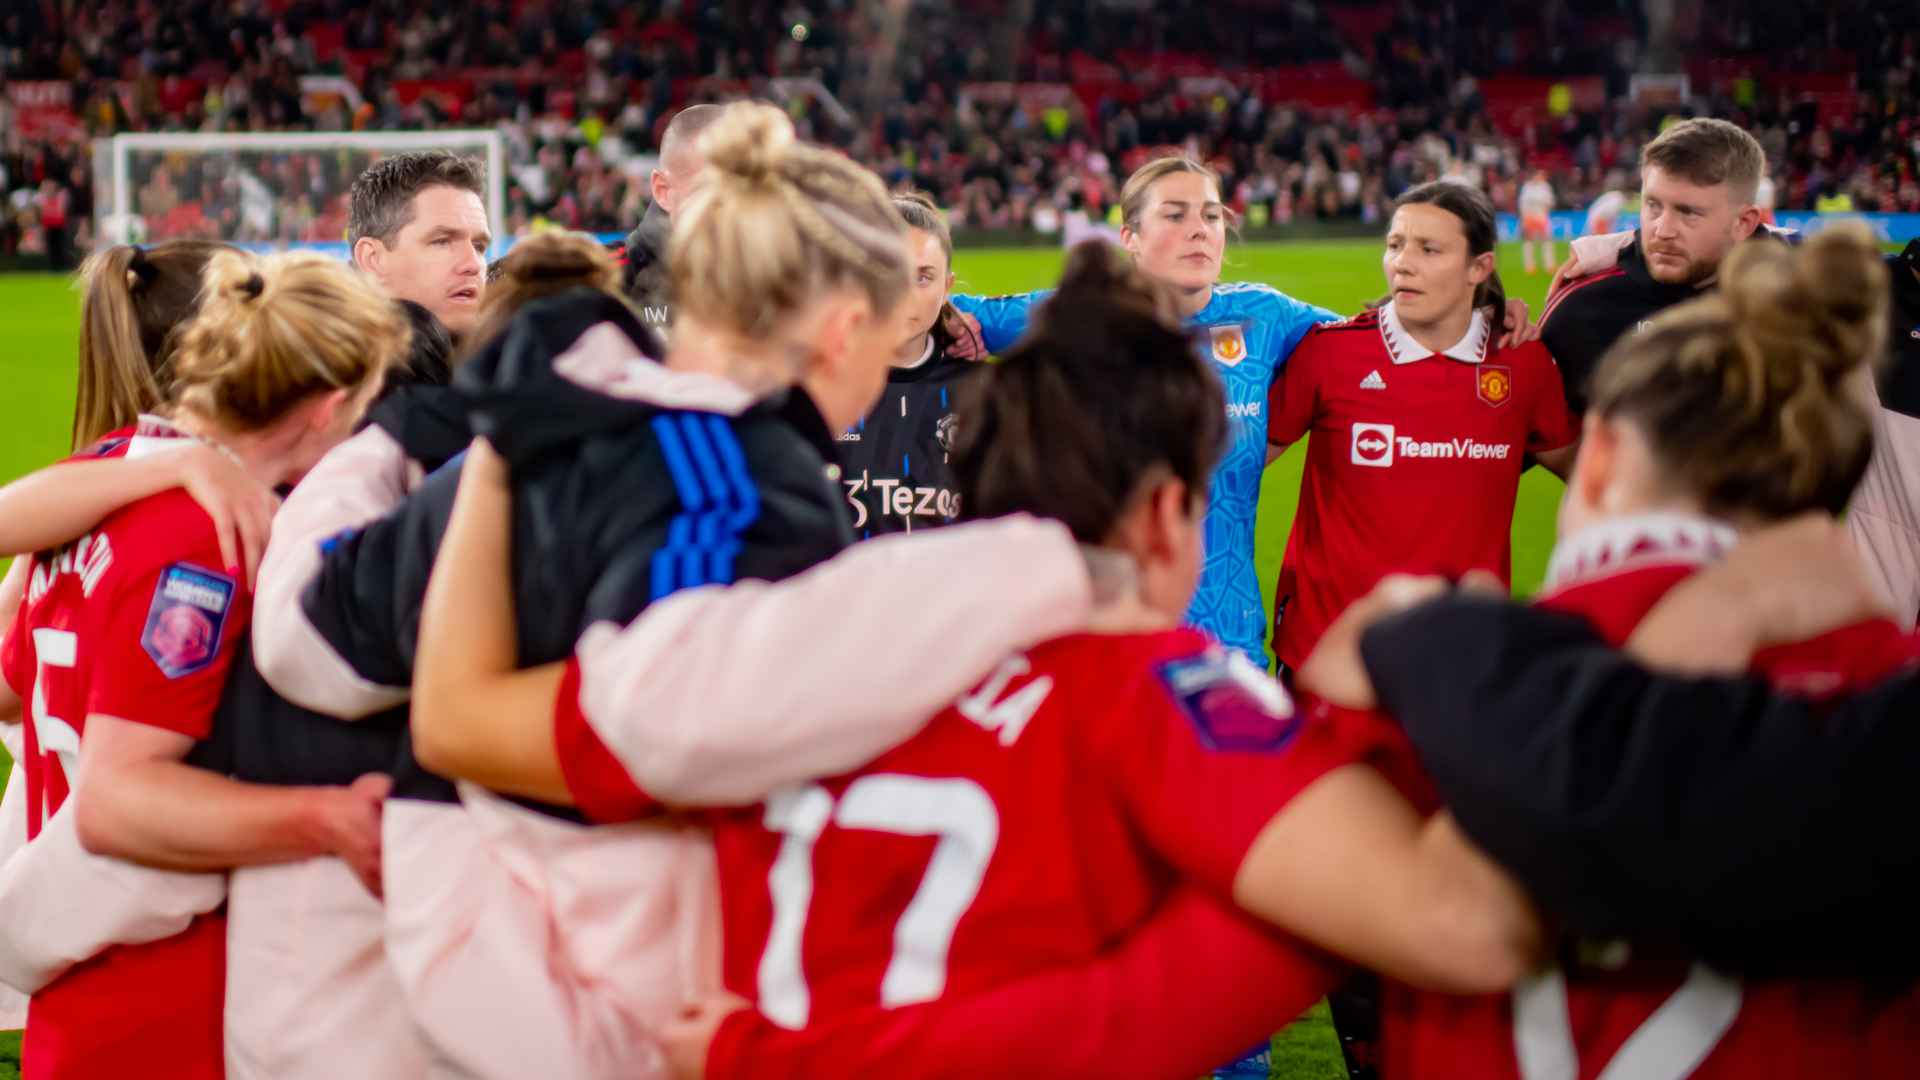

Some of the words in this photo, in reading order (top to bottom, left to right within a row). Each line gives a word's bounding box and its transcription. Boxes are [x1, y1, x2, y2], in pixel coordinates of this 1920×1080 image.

[1396, 436, 1511, 460] TeamViewer
[872, 479, 961, 519] Tezos
[757, 773, 1000, 1031] 17
